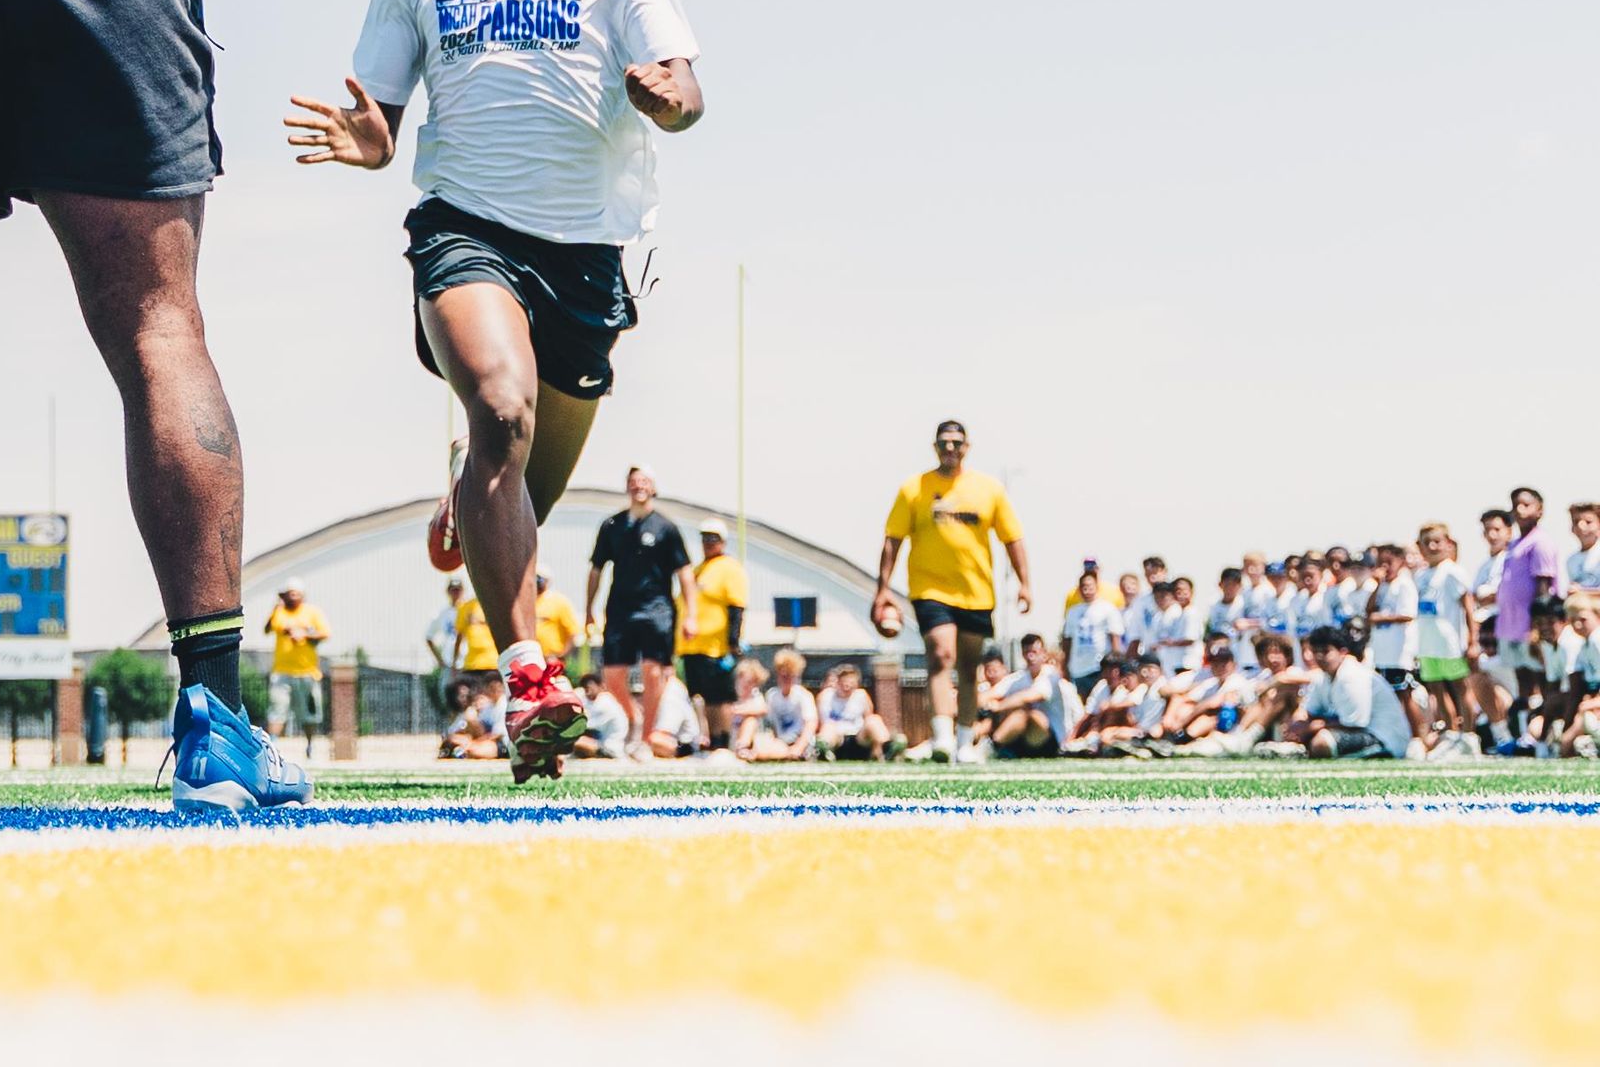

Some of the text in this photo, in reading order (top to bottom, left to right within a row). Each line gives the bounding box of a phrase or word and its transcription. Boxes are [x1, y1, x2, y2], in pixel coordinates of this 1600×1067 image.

[457, 43, 487, 56] YOUTH
[550, 40, 581, 52] CAMP
[190, 756, 208, 780] 11
